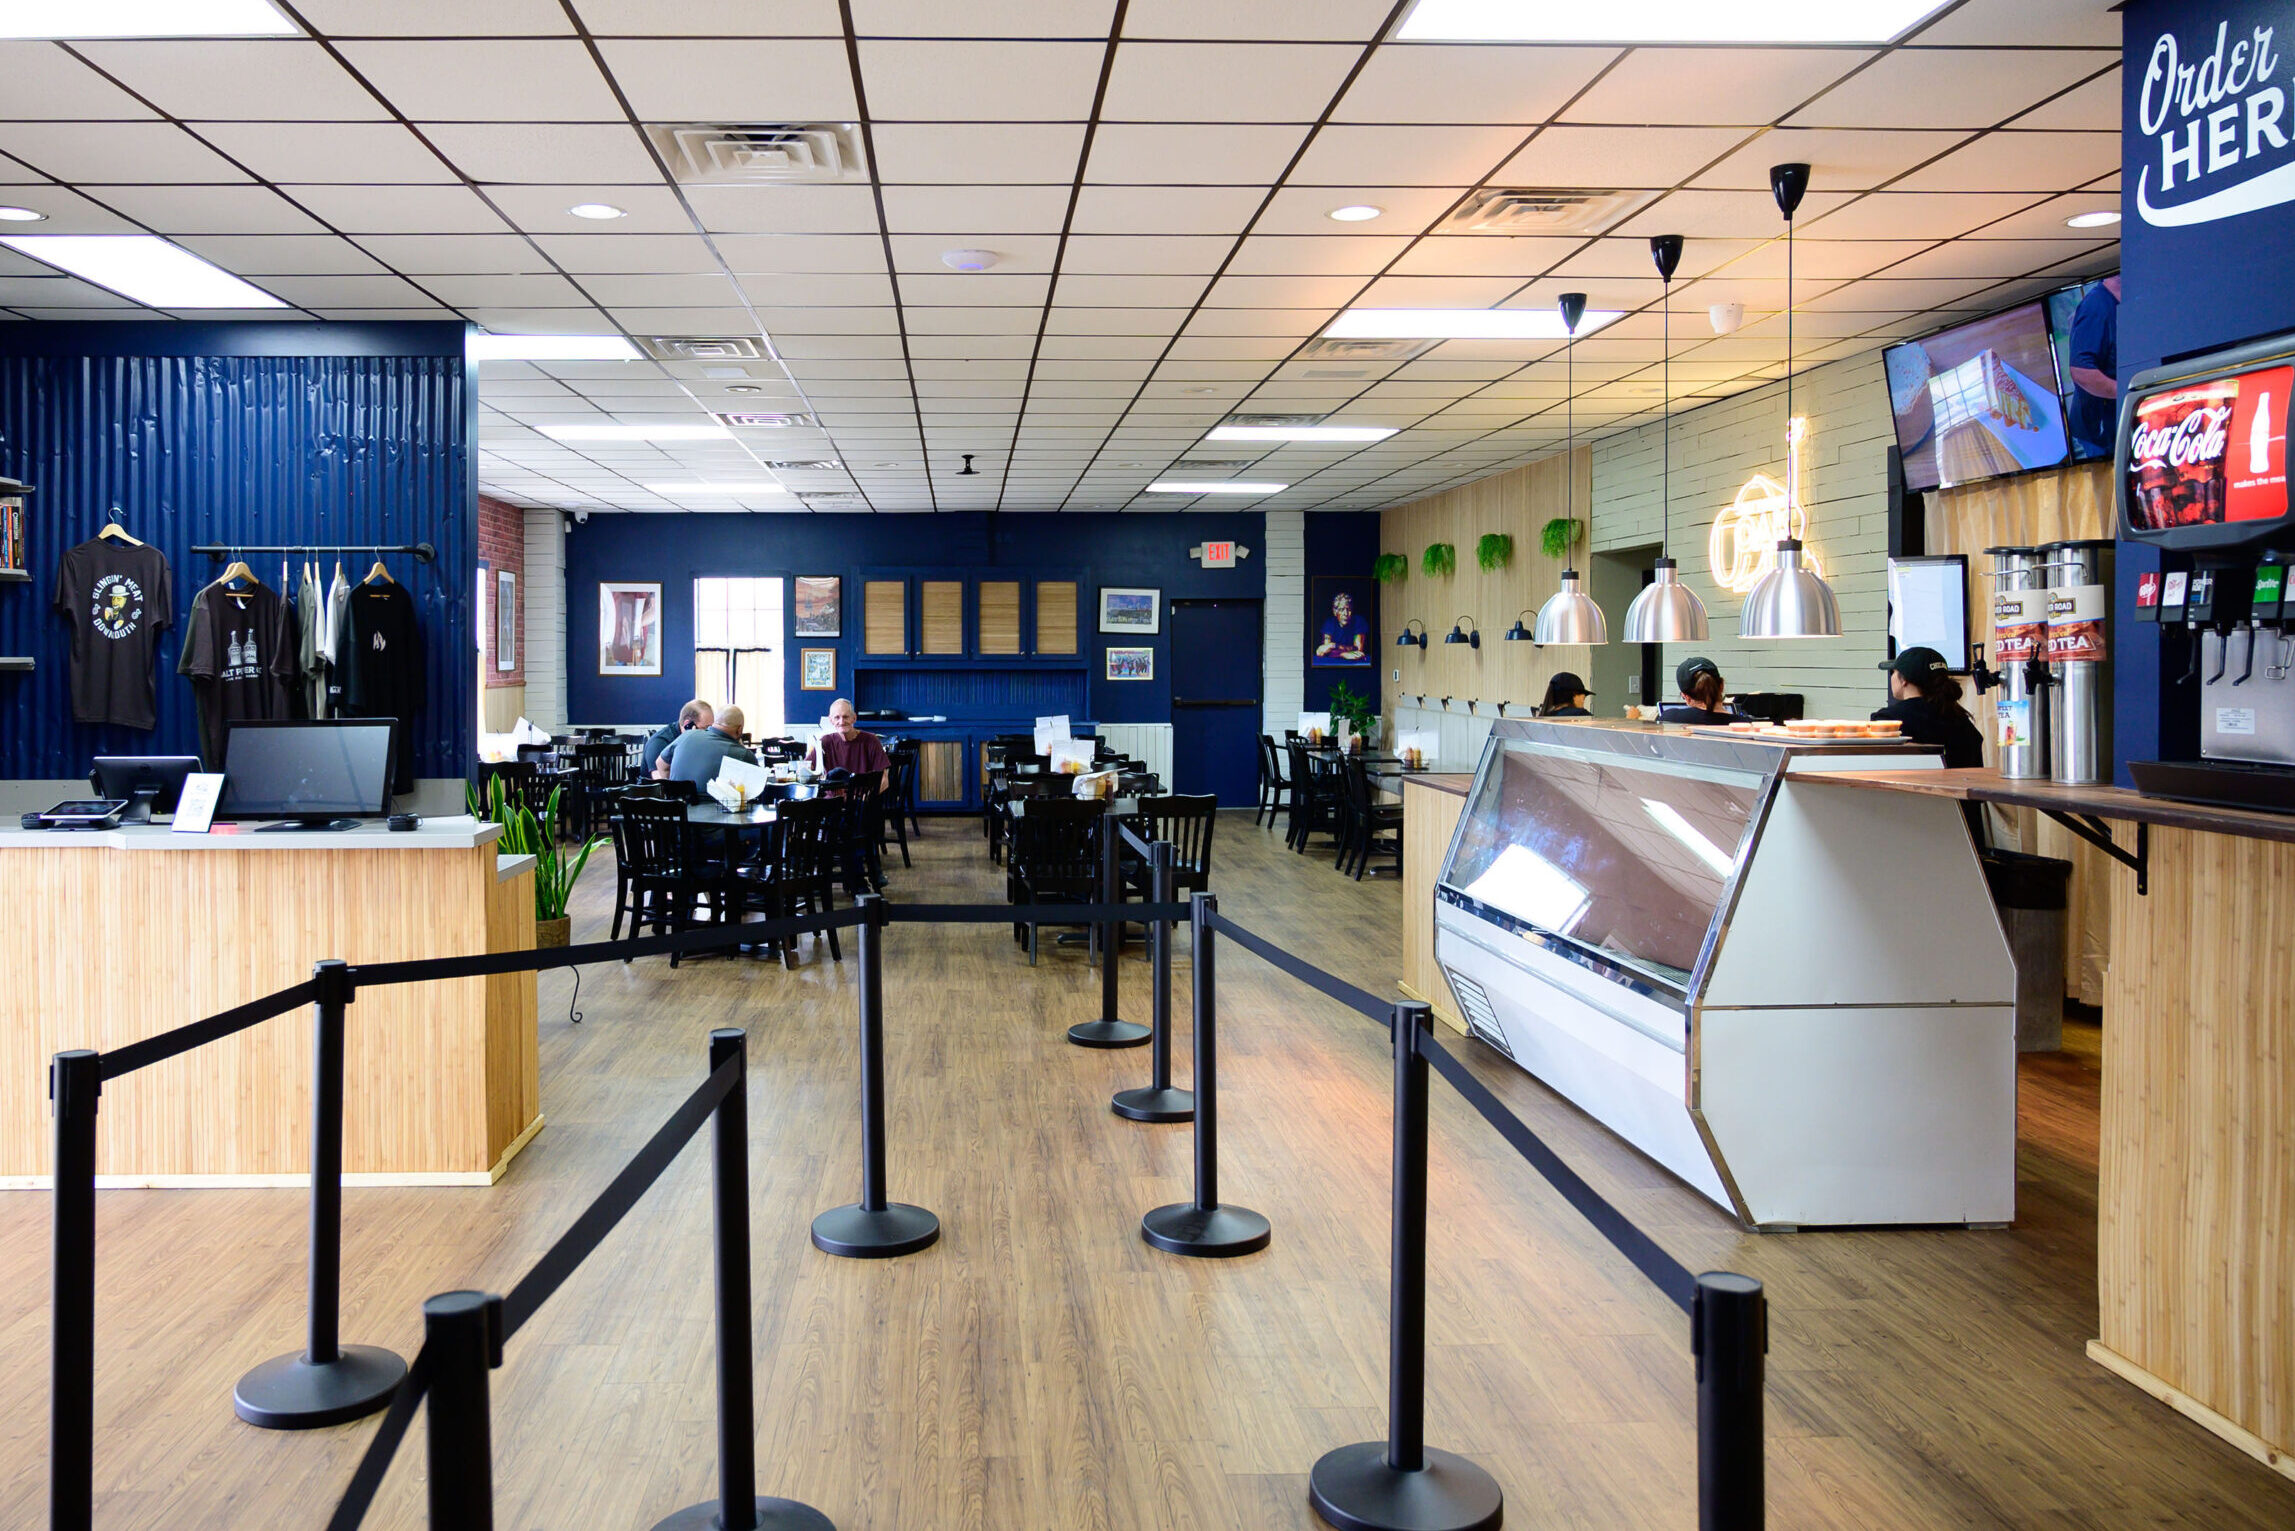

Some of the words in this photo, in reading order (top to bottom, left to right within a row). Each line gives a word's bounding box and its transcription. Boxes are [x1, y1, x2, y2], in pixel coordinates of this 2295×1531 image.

[2139, 20, 2279, 136] Order
[2160, 77, 2295, 192] HER
[2131, 406, 2232, 470] Coca-Cola
[2256, 477, 2269, 486] the
[2269, 475, 2286, 483] mea
[1208, 543, 1231, 561] EXIT
[124, 577, 144, 602] MEAT
[2054, 601, 2072, 612] ROAD
[2005, 637, 2032, 652] TEA
[2057, 635, 2090, 651] TEA
